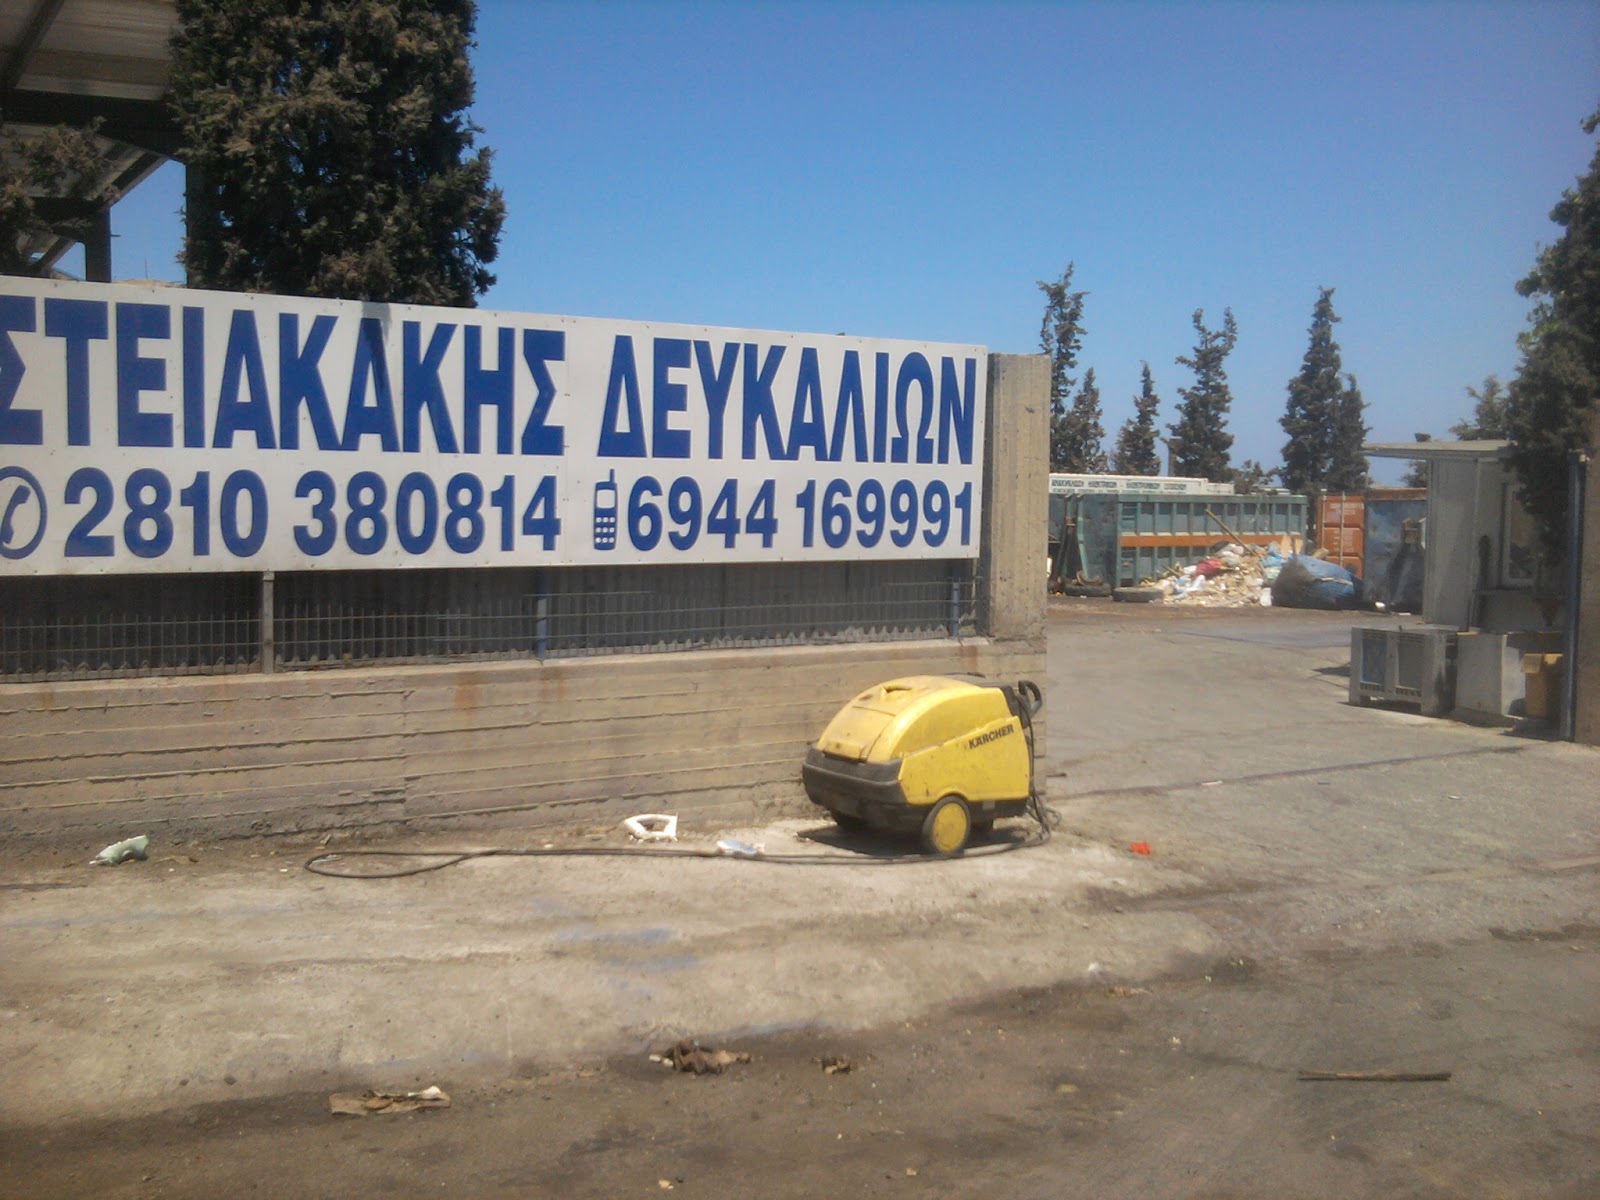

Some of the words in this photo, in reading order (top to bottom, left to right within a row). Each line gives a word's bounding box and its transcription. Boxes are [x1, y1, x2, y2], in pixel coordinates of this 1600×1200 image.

[597, 334, 976, 465] ΔΕΥΚΑΛΙΩΝ
[64, 466, 269, 558] 2810
[293, 469, 561, 556] 380814
[628, 475, 778, 552] 6944
[796, 477, 973, 548] 169991
